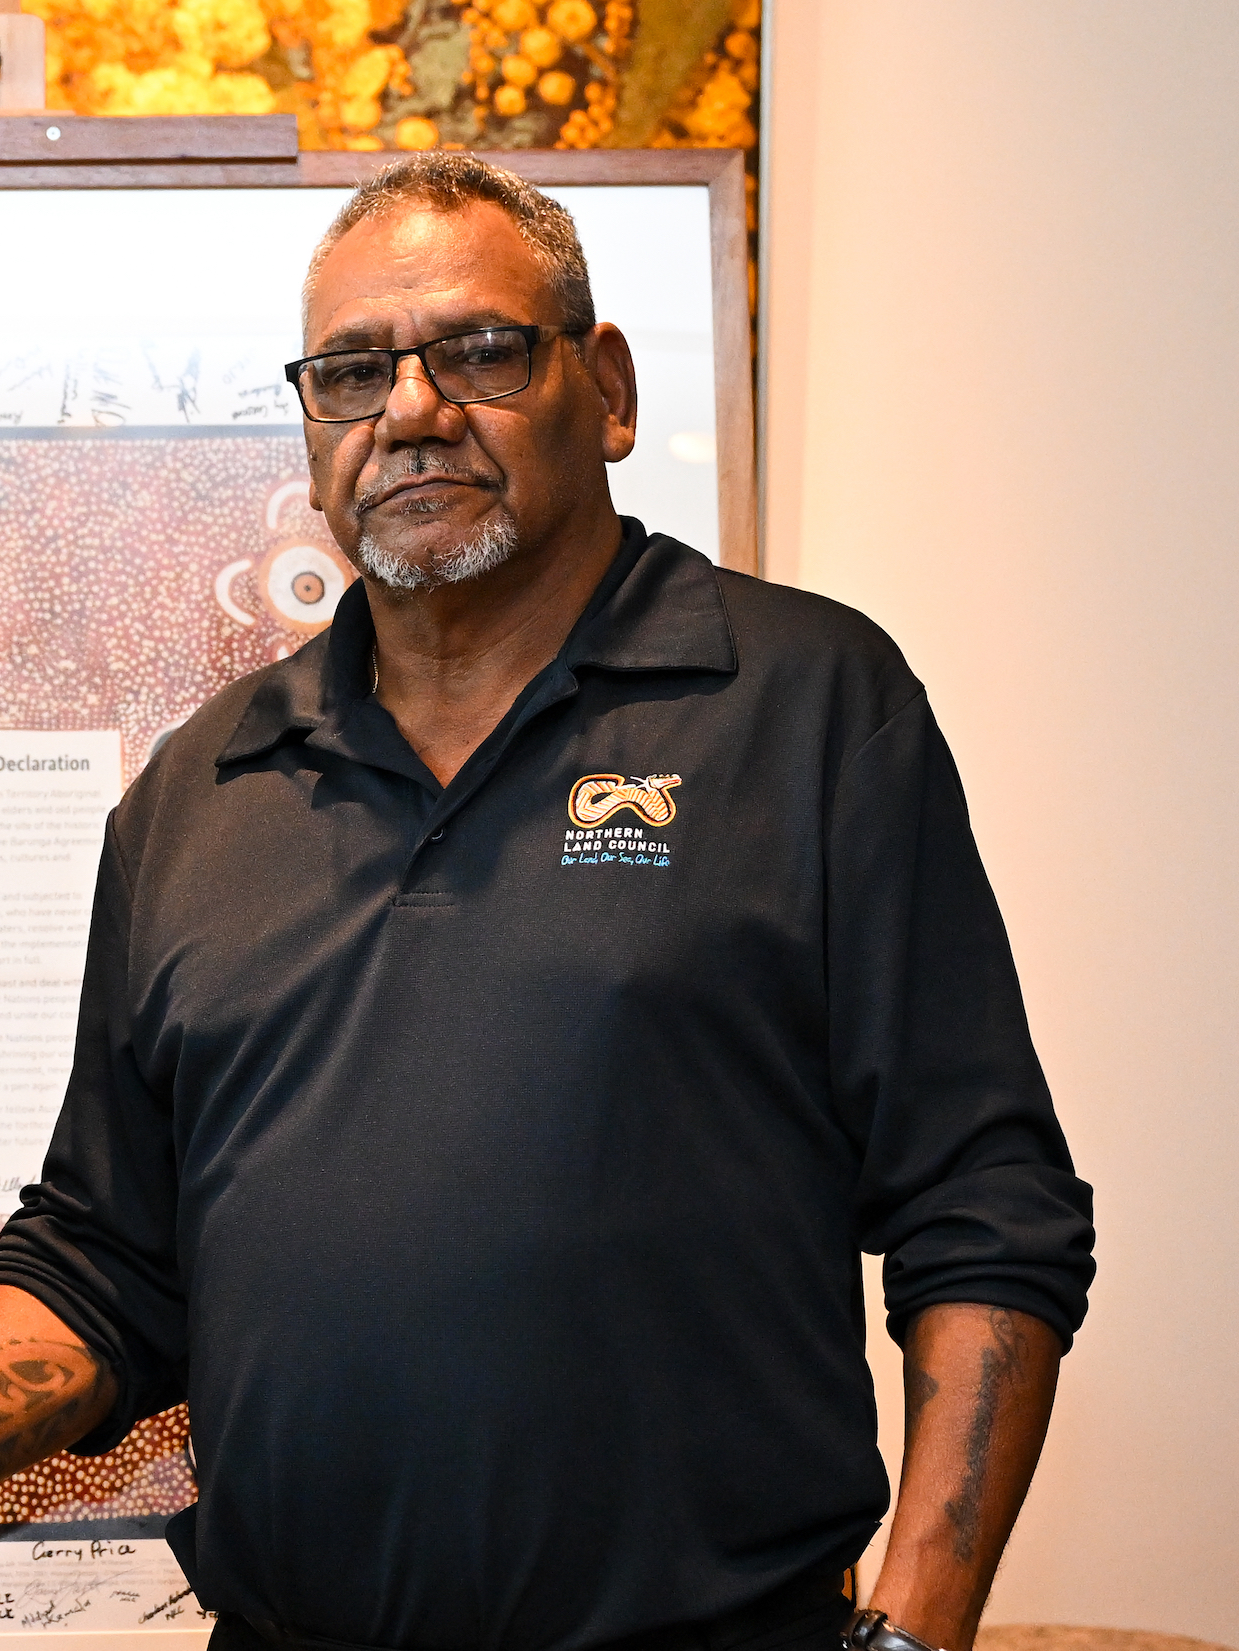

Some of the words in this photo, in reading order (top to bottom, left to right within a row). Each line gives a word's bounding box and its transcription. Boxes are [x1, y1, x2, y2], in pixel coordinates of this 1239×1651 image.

[565, 828, 643, 840] NORTHERN
[564, 841, 602, 852] LAND
[608, 840, 670, 853] COUNCIL
[561, 855, 577, 865] Our
[601, 852, 617, 862] Our
[635, 854, 651, 864] Our
[653, 854, 670, 866] Life
